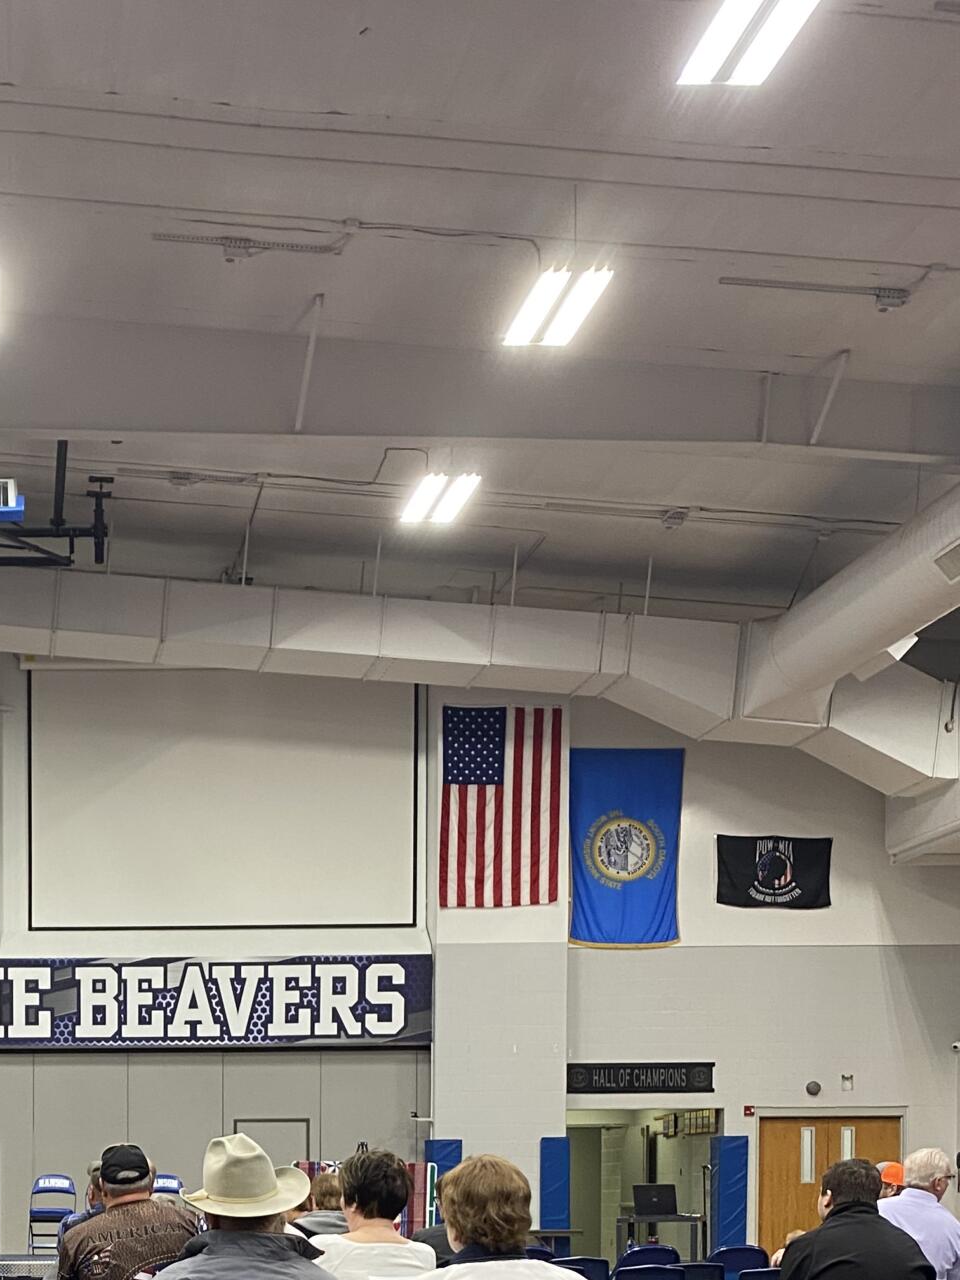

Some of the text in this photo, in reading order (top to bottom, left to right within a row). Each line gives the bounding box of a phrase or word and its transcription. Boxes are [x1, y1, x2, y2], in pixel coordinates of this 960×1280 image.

[75, 963, 406, 1039] BEAVERS
[592, 1068, 687, 1087] HALL OF CHAMPIONS
